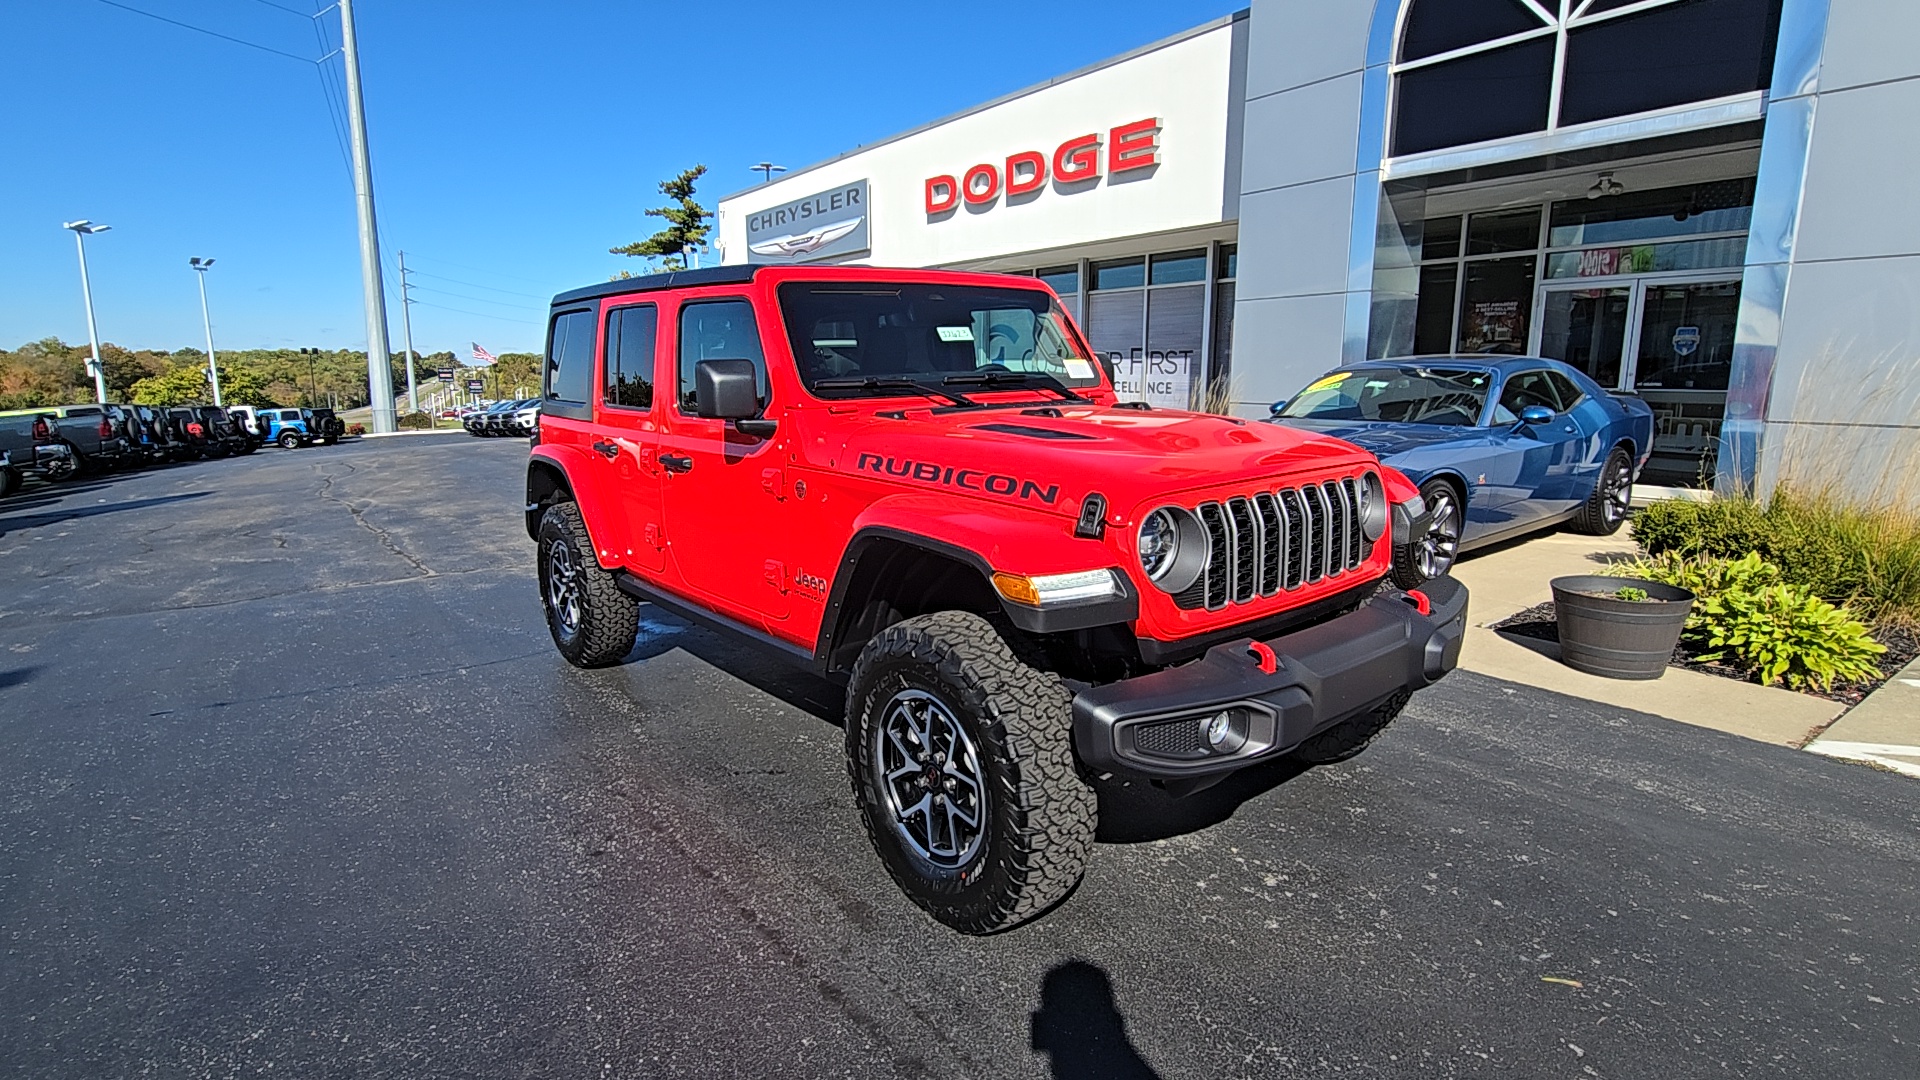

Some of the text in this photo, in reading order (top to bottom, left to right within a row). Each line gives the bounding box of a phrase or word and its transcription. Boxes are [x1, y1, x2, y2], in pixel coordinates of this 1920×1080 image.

[925, 117, 1161, 214] DODGE
[750, 188, 860, 232] CHRYSLER
[1130, 347, 1194, 375] FIRST
[1113, 381, 1173, 395] CELLNCE
[858, 453, 1060, 504] RUBICON
[794, 567, 827, 597] Jeep
